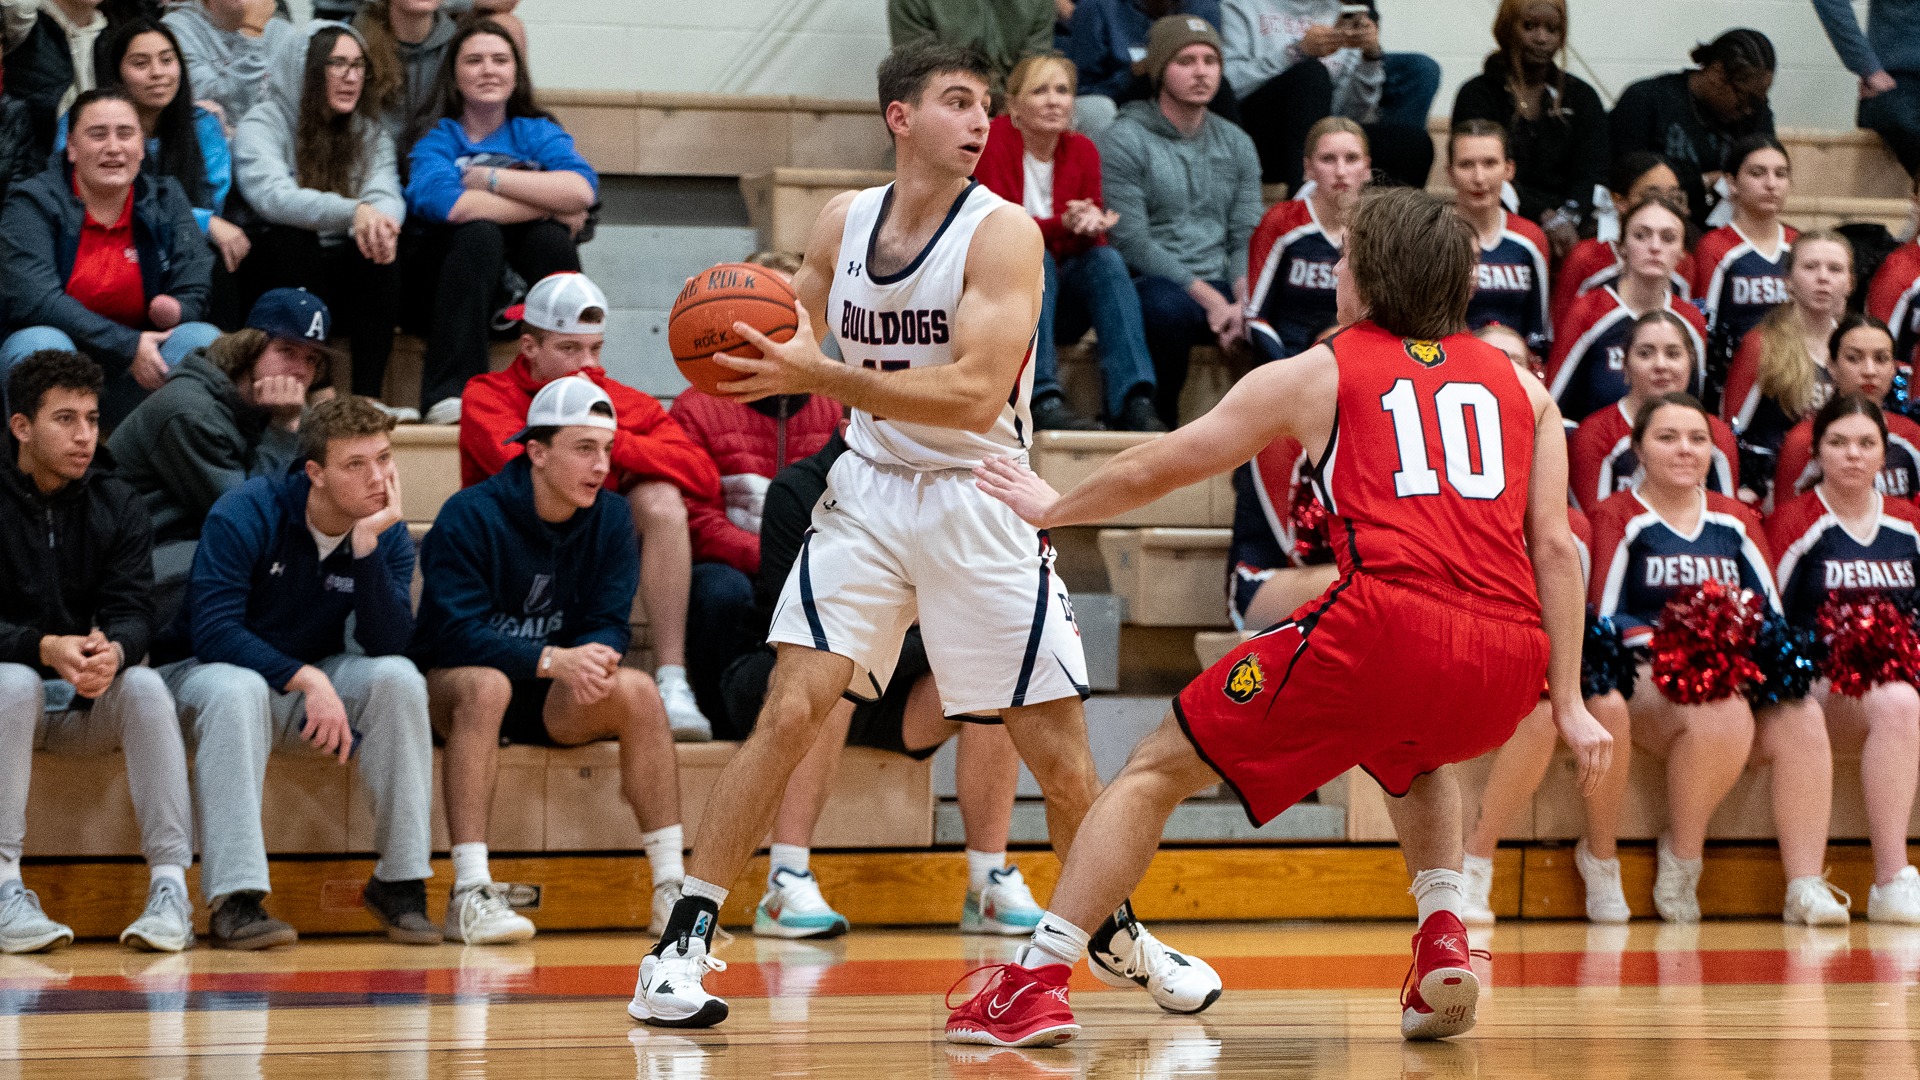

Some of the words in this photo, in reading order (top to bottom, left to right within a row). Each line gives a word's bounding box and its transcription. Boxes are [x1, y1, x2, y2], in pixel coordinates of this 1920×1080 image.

[304, 310, 325, 341] A
[841, 299, 950, 346] BULLDOGS
[1380, 377, 1507, 501] 10
[1823, 559, 1917, 590] DESALES
